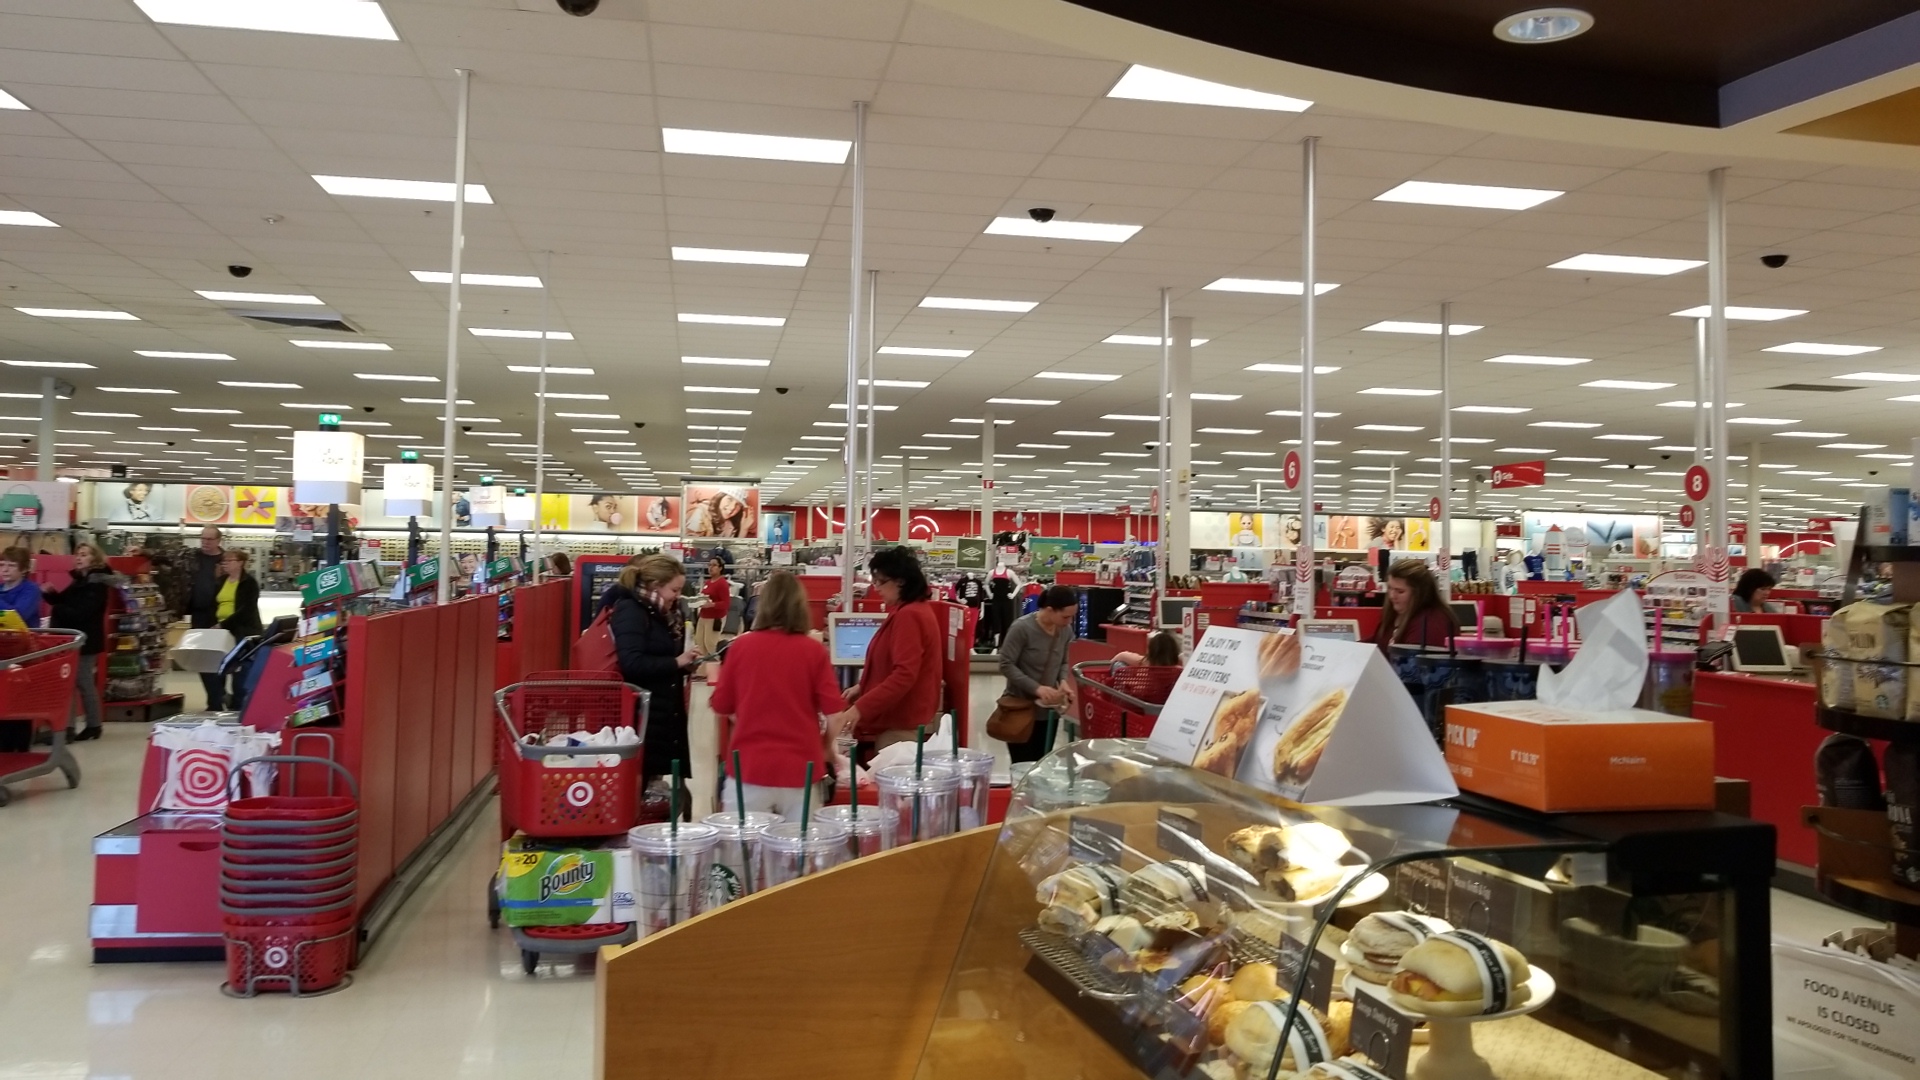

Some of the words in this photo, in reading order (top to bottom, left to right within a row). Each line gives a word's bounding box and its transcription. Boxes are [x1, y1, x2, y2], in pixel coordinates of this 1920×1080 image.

[1288, 461, 1296, 479] 6
[1692, 475, 1703, 492] 8
[1682, 510, 1693, 522] 11
[1204, 636, 1227, 649] ENJOY
[1224, 639, 1242, 651] TWO
[1196, 651, 1229, 666] DELICIOUS
[1187, 666, 1212, 681] BAKERY
[1209, 670, 1232, 684] ITEMS
[1446, 723, 1465, 746] PICK
[1465, 727, 1478, 749] UP
[538, 860, 596, 904] Bounty
[1803, 978, 1840, 999] FOOD
[1840, 990, 1896, 1017] AVENUE
[1816, 1005, 1829, 1019] IS
[1830, 1010, 1881, 1035] CLOSED
